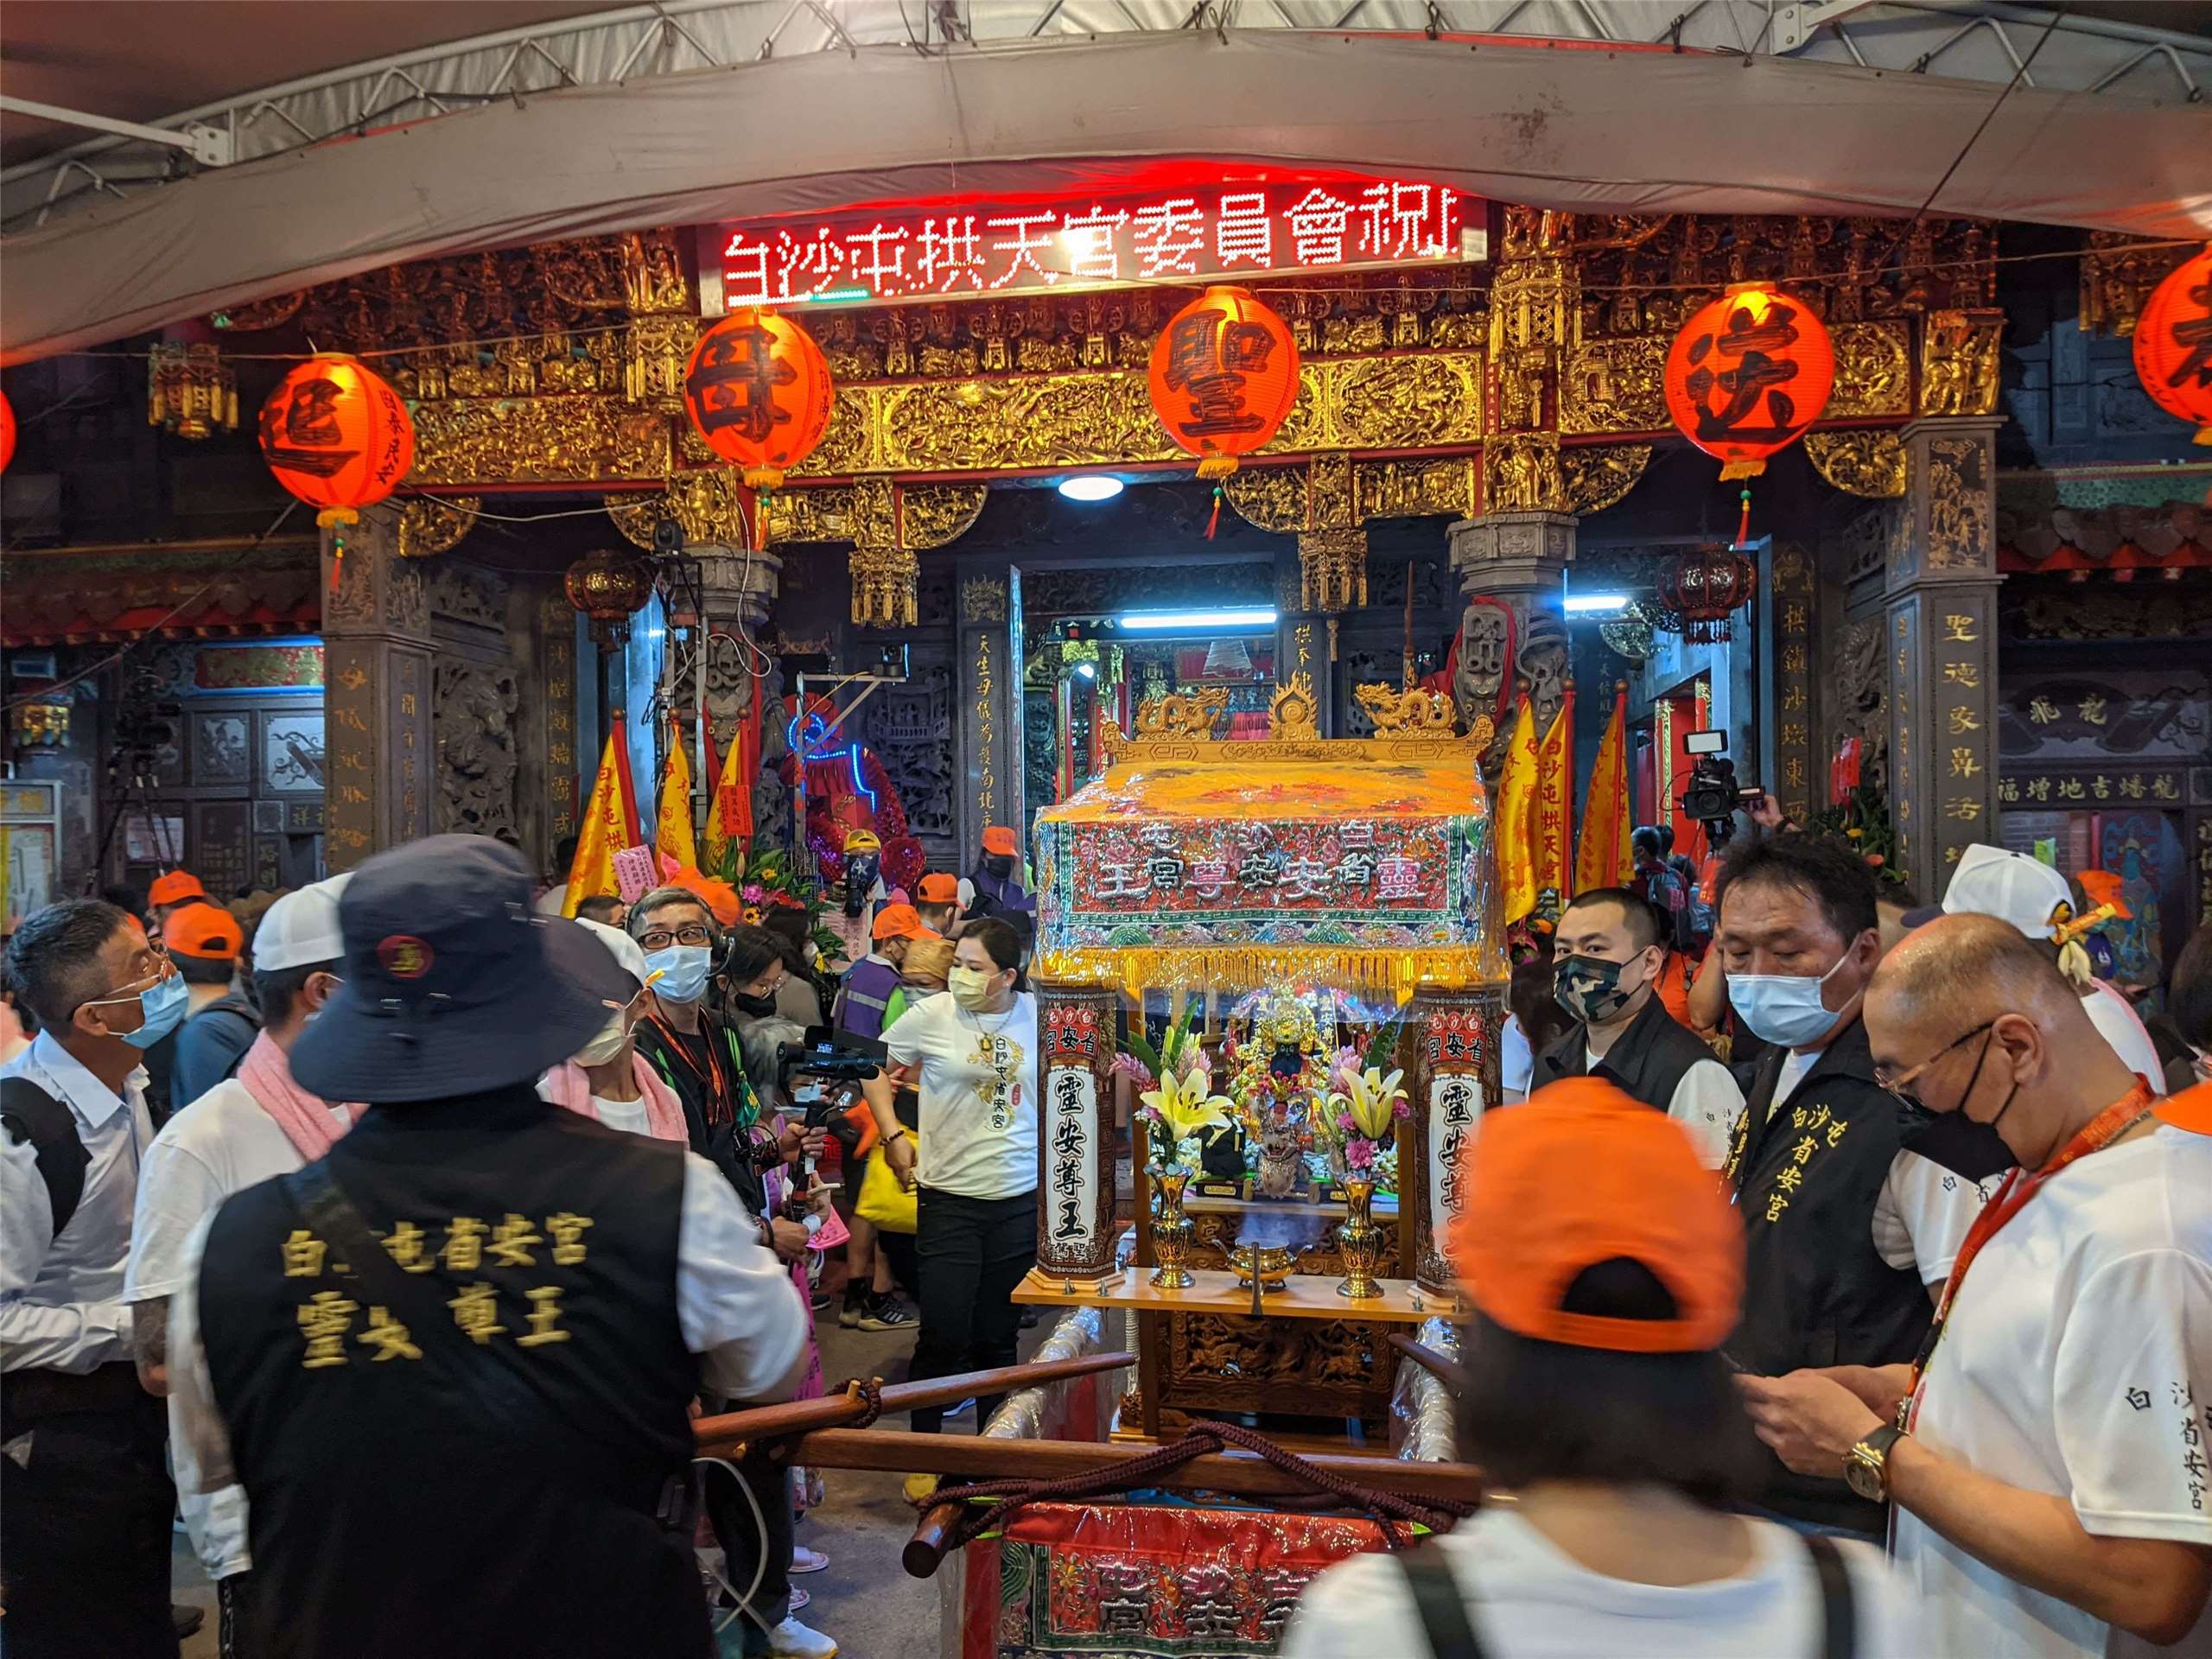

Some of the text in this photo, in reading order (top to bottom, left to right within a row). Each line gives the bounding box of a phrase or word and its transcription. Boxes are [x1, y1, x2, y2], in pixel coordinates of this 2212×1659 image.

[686, 326, 798, 443] 母
[1163, 308, 1277, 437] 聖
[1686, 302, 1812, 445] 送
[598, 765, 626, 893] 白沙屯拱
[1053, 1074, 1088, 1240] 靈安尊王
[1440, 1083, 1474, 1259] 靈安尊
[280, 1211, 595, 1278] 白屯省安宮
